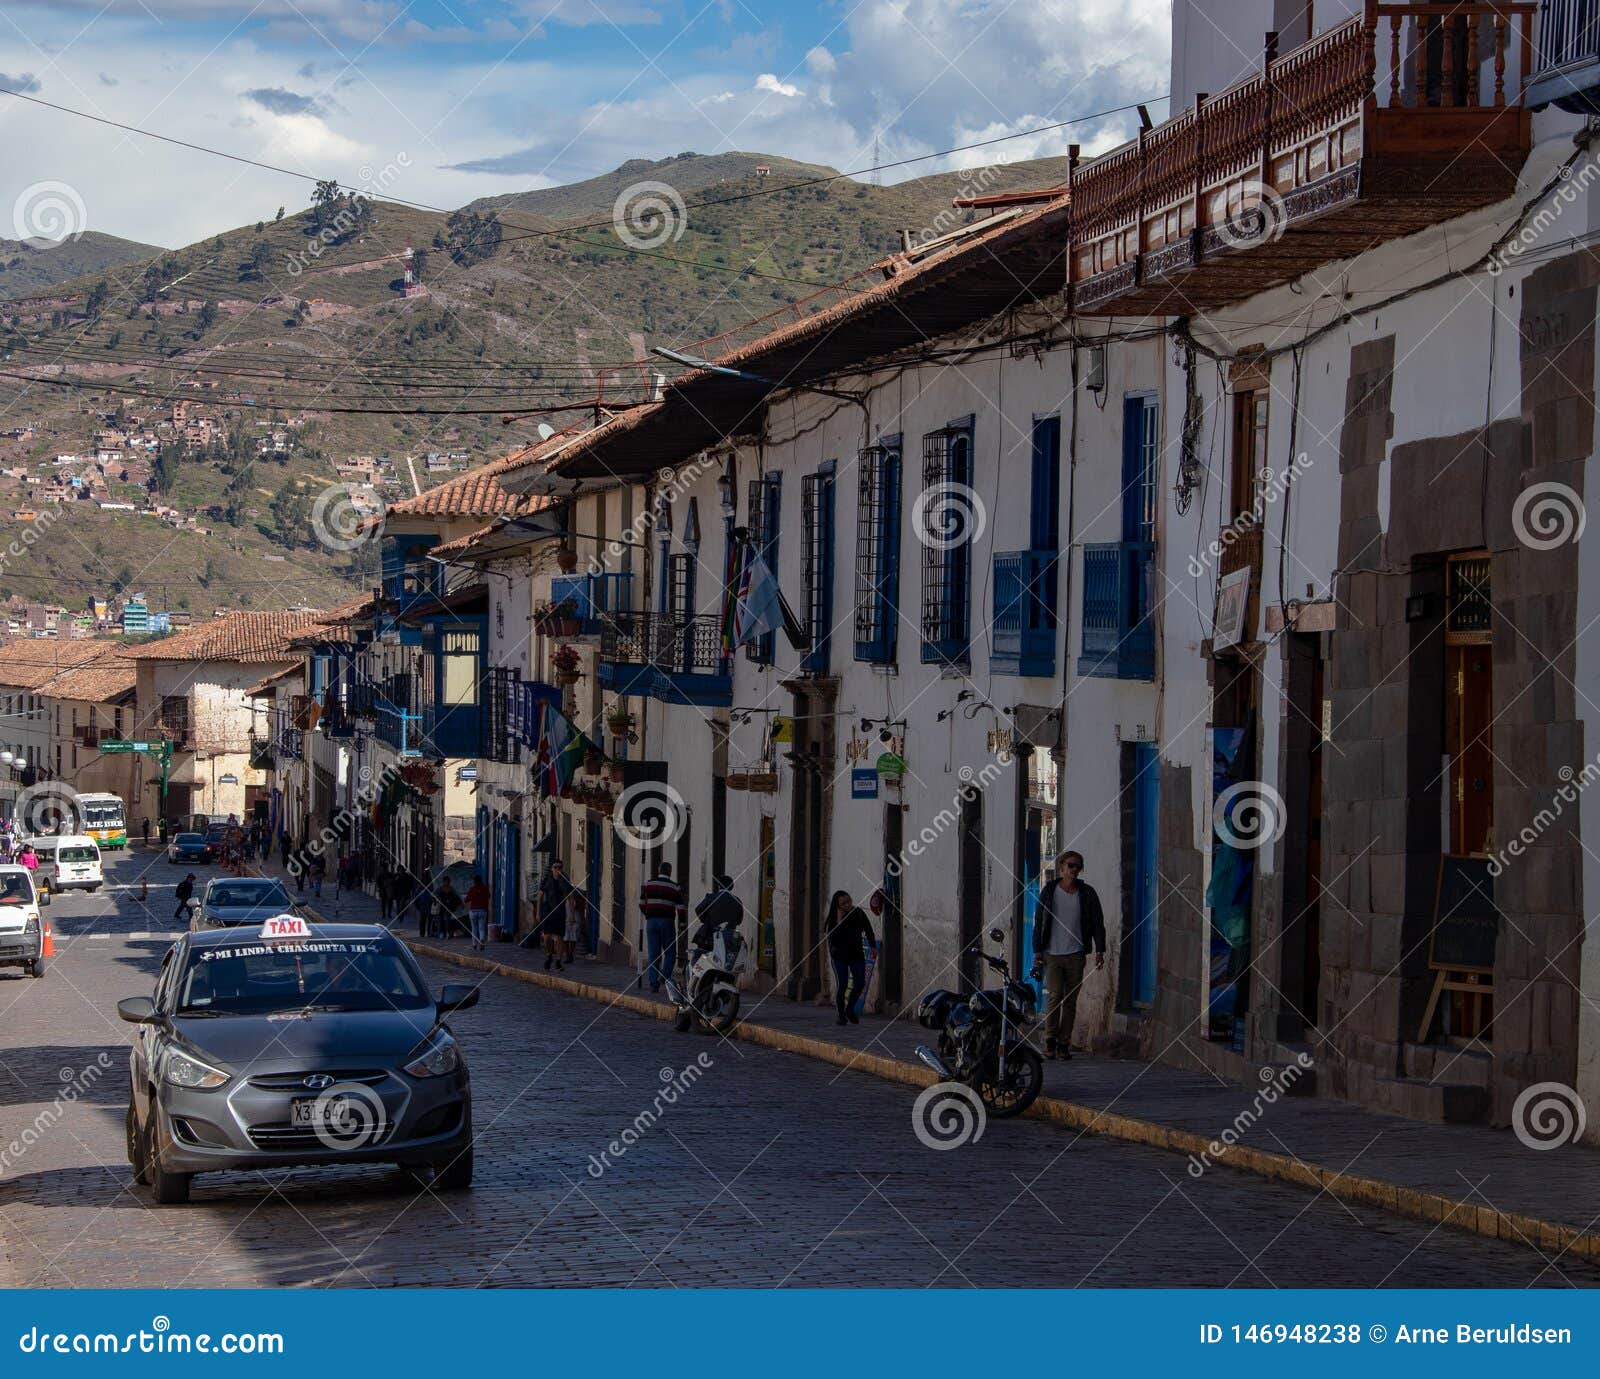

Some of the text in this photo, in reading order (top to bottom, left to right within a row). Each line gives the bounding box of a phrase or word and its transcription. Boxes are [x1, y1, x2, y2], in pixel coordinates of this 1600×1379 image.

[270, 921, 302, 934] TAXI
[216, 950, 232, 960] MI
[236, 946, 274, 957] LINDA
[277, 944, 347, 954] CHASQUITA
